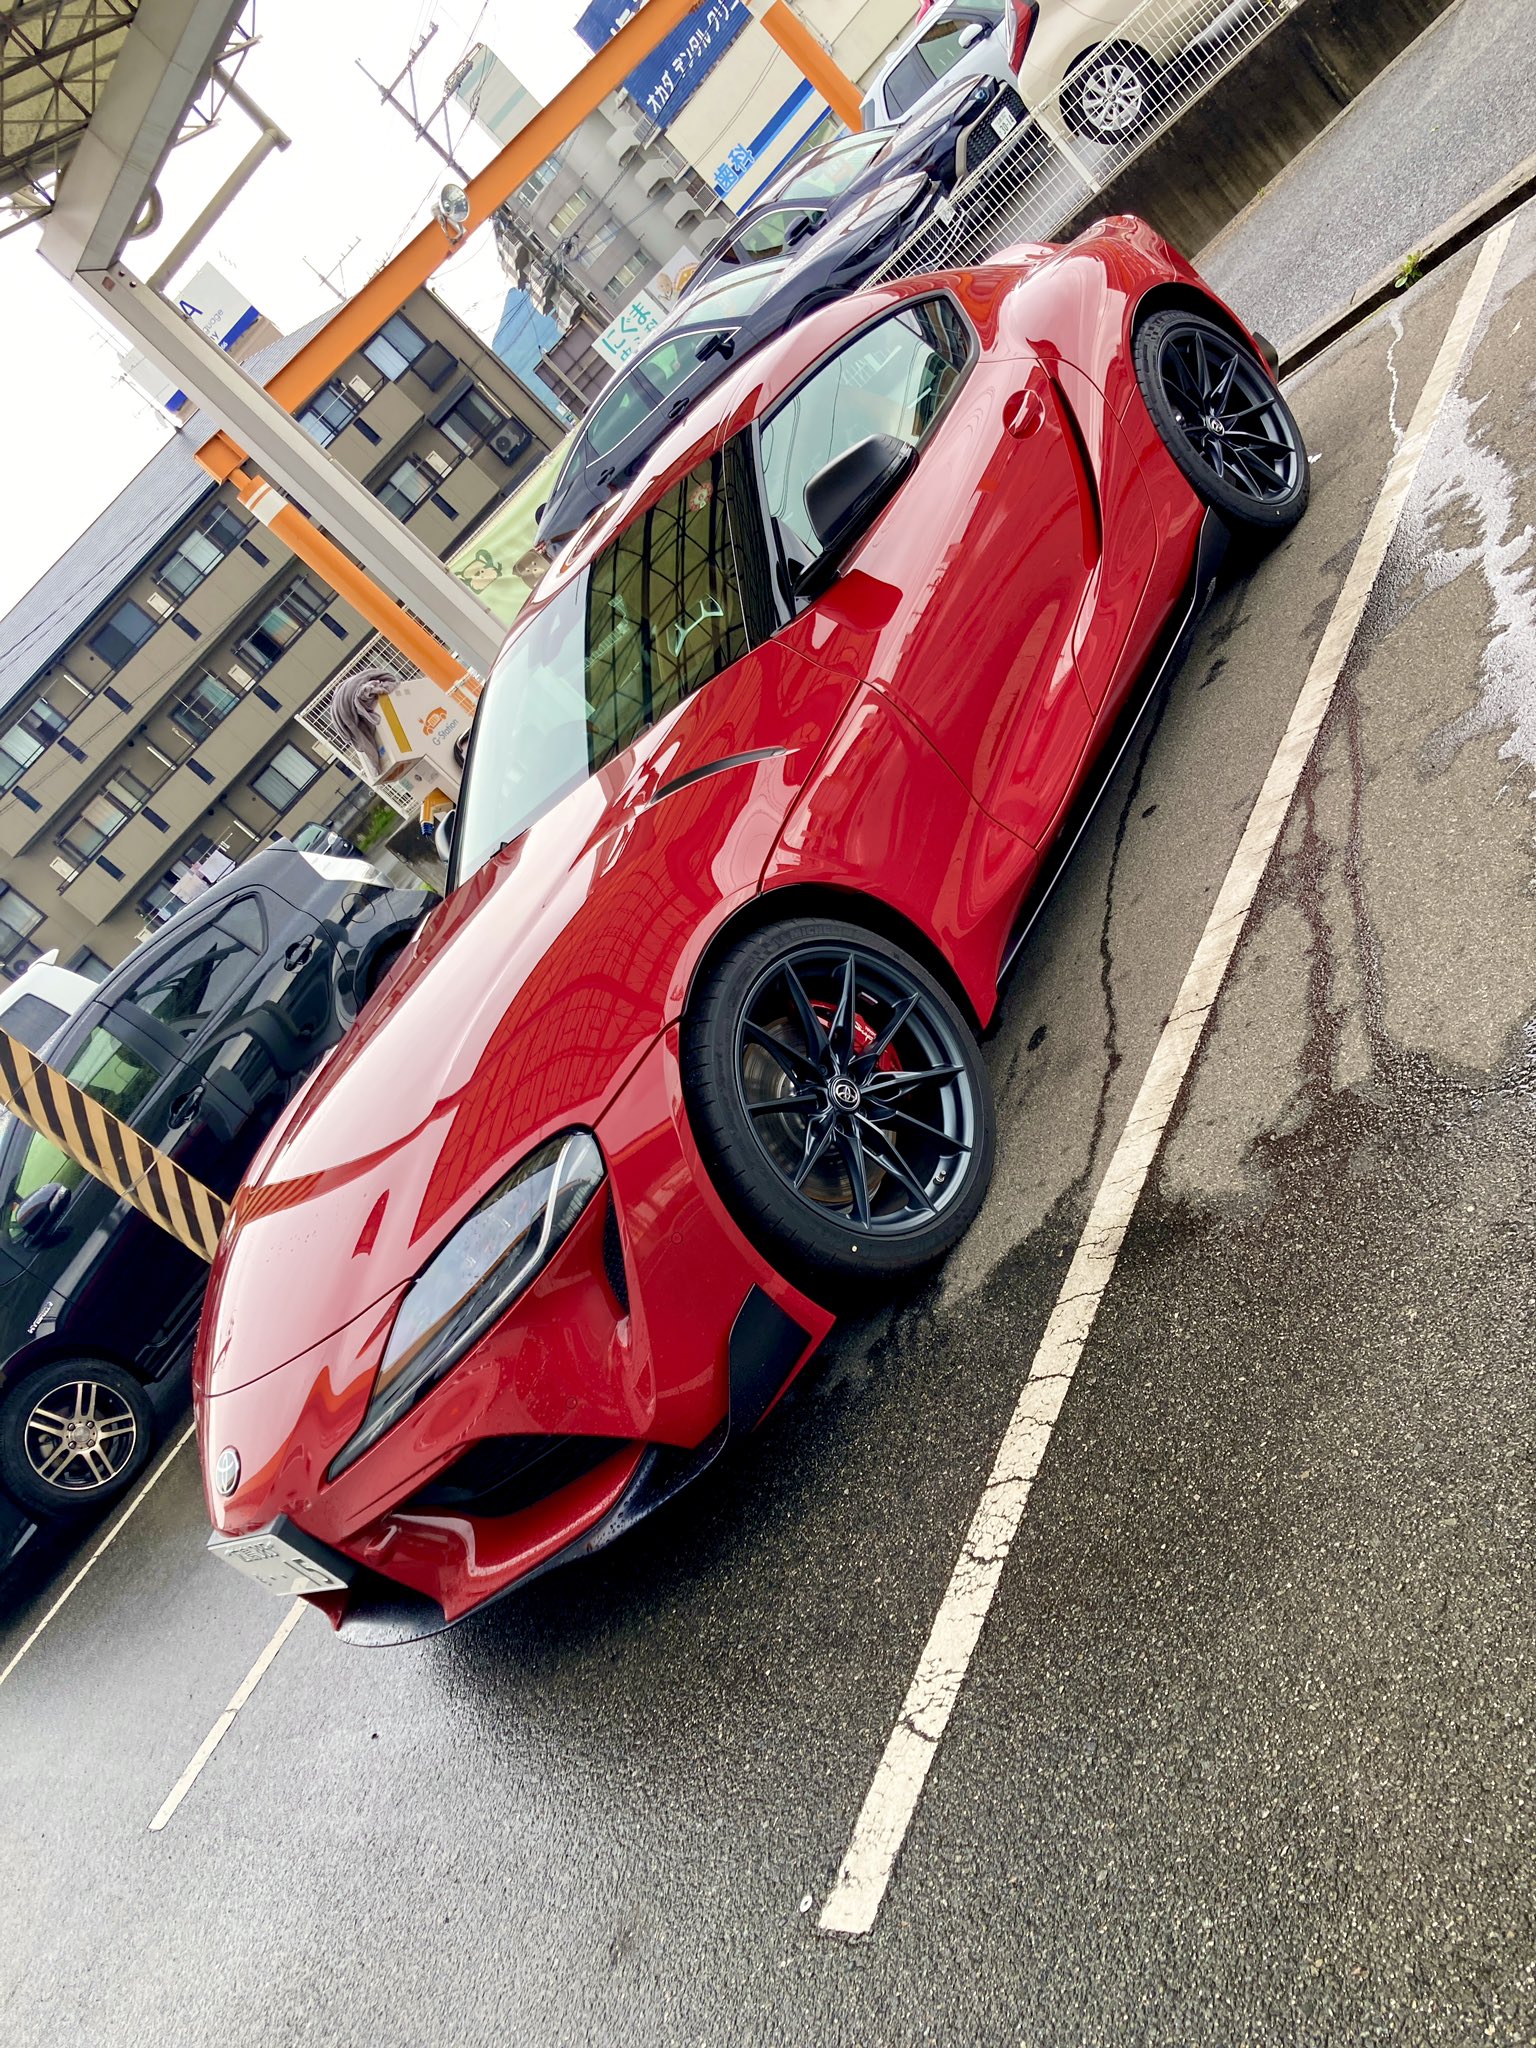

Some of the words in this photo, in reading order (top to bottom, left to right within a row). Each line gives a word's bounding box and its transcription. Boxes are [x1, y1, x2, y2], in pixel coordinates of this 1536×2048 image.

[646, 69, 675, 114] オカダ
[671, 28, 711, 79] デンタル
[714, 143, 754, 192] 歯科
[602, 302, 651, 355] にぐま
[432, 719, 460, 746] G-Station
